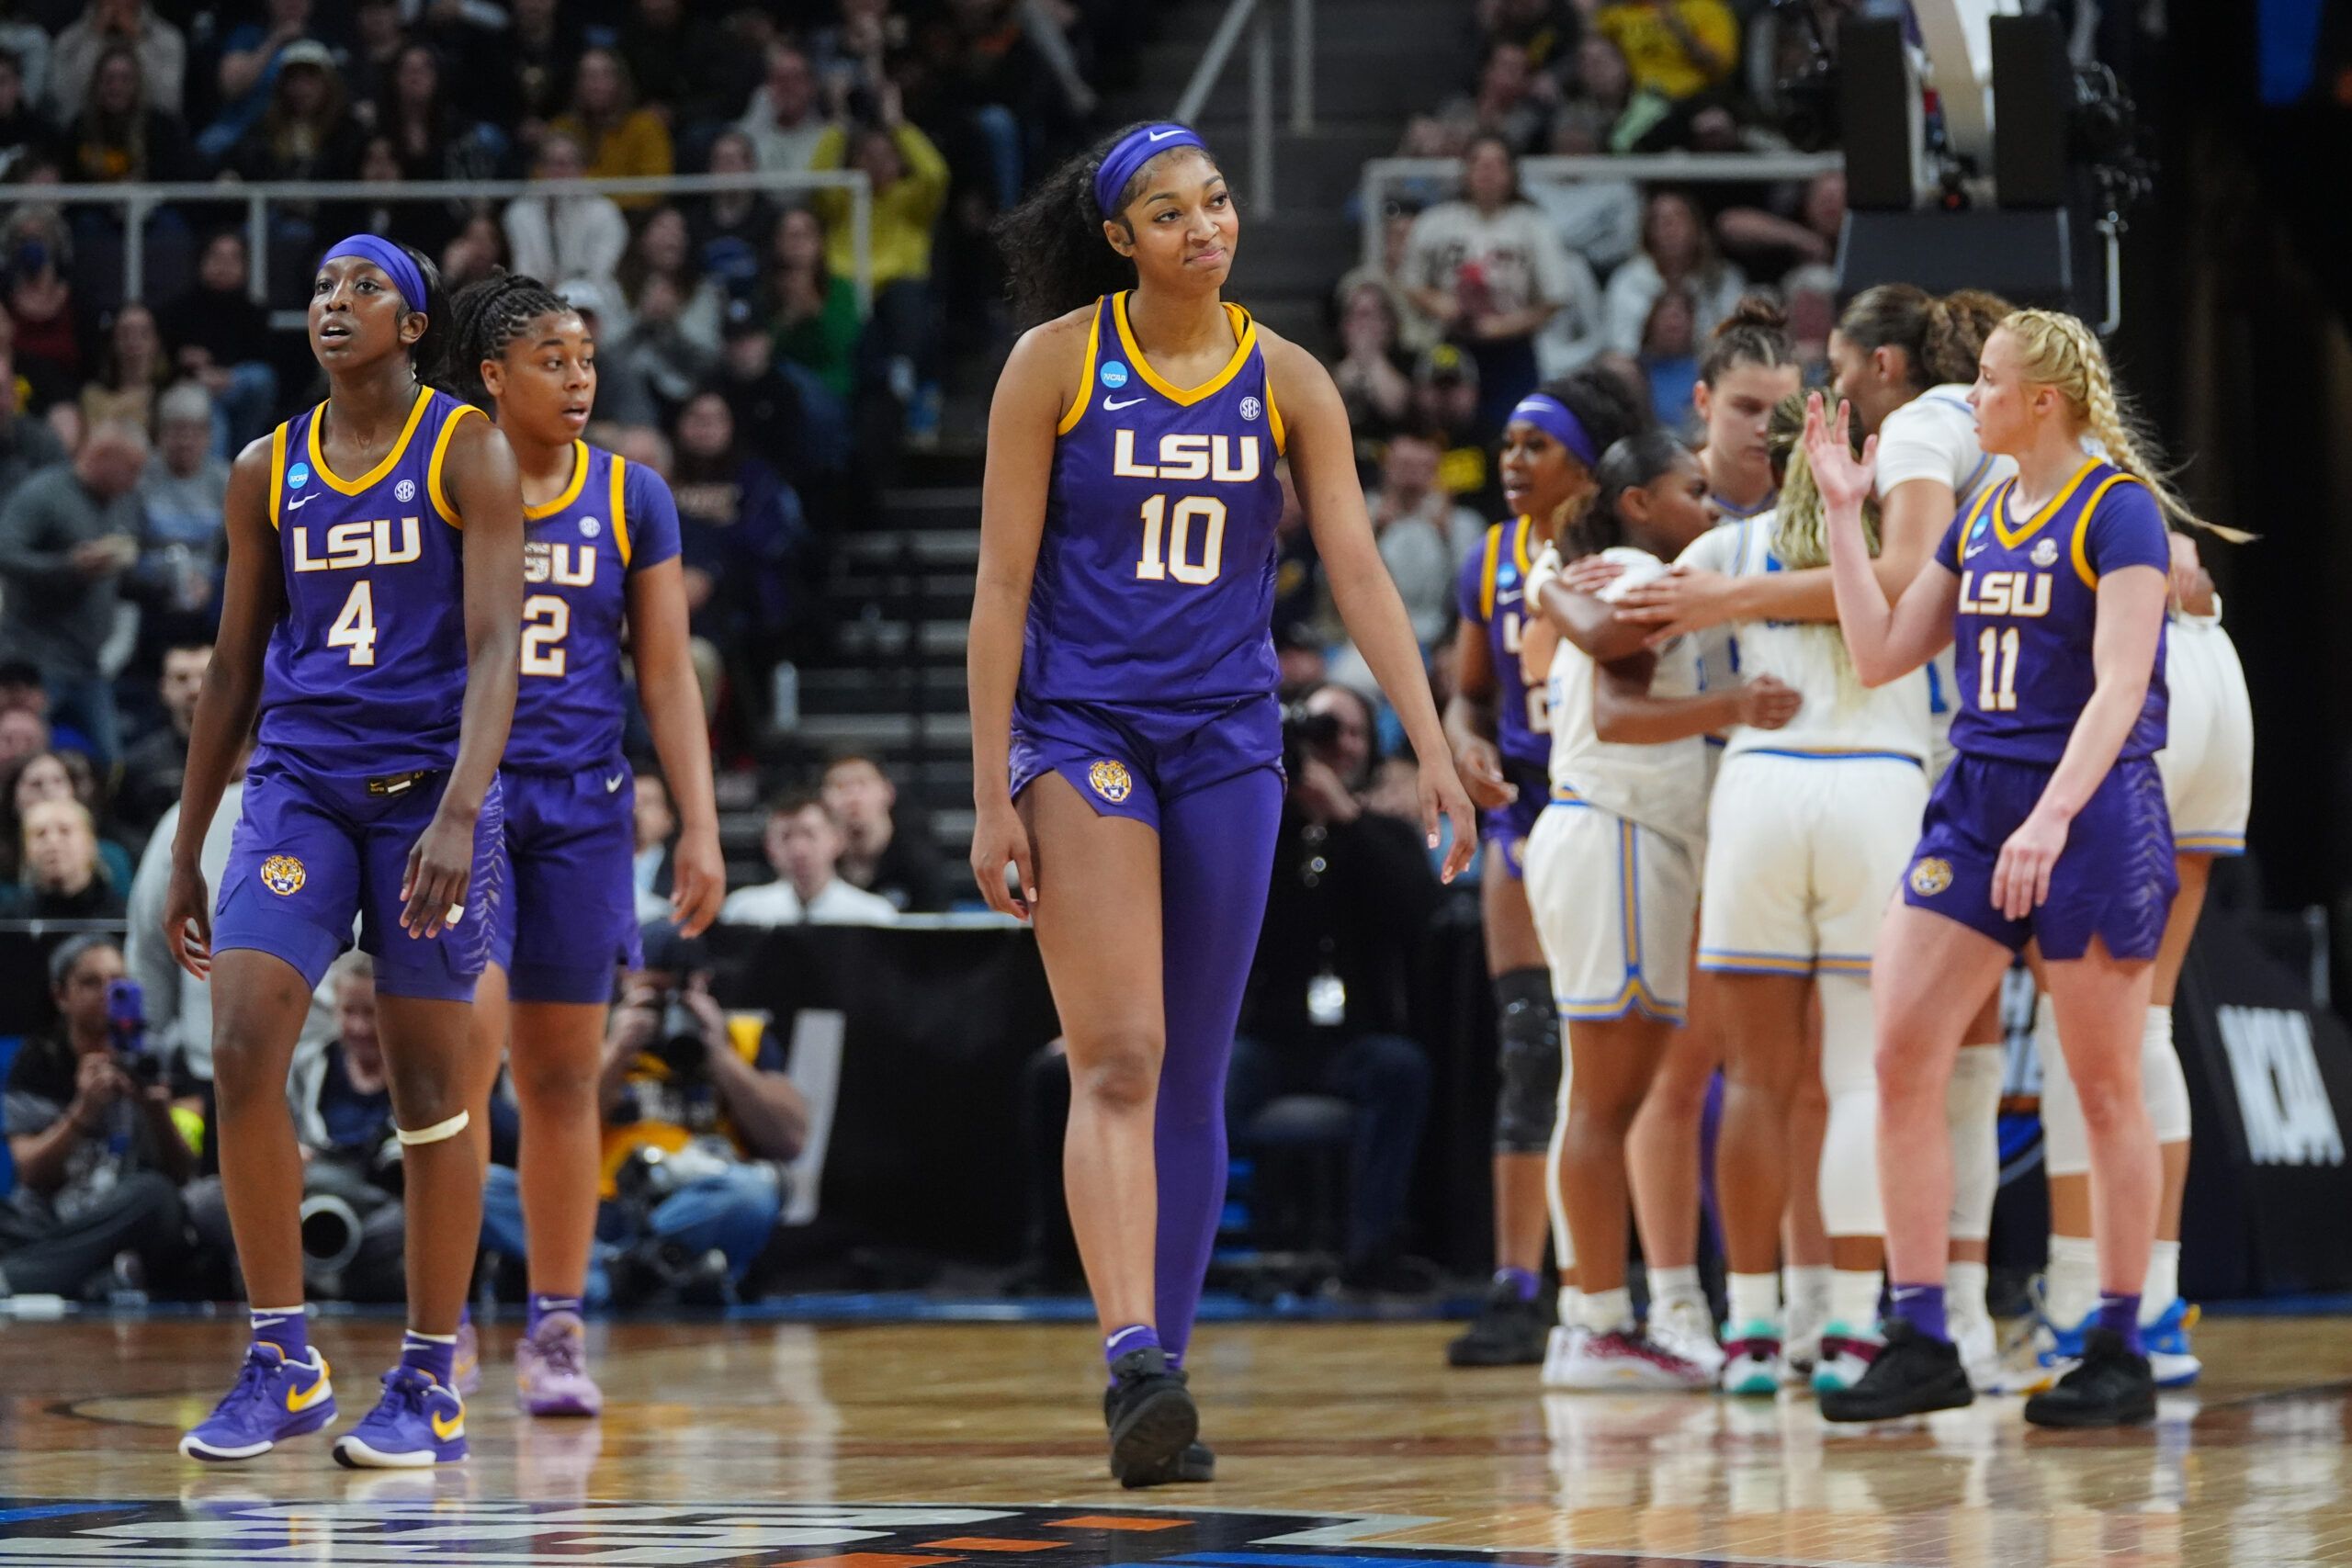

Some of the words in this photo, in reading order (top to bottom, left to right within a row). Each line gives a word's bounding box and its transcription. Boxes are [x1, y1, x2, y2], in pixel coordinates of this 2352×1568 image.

[1103, 372, 1126, 383] NCAA
[1241, 398, 1261, 419] SEC
[1114, 429, 1260, 482] LSU
[395, 480, 414, 502] SEC
[292, 516, 421, 572] LSU
[525, 540, 596, 587] SU
[1136, 494, 1227, 585] 10
[1958, 570, 2052, 617] LSU
[327, 580, 377, 666] 4
[517, 593, 570, 677] 2
[1978, 626, 2019, 712] 11
